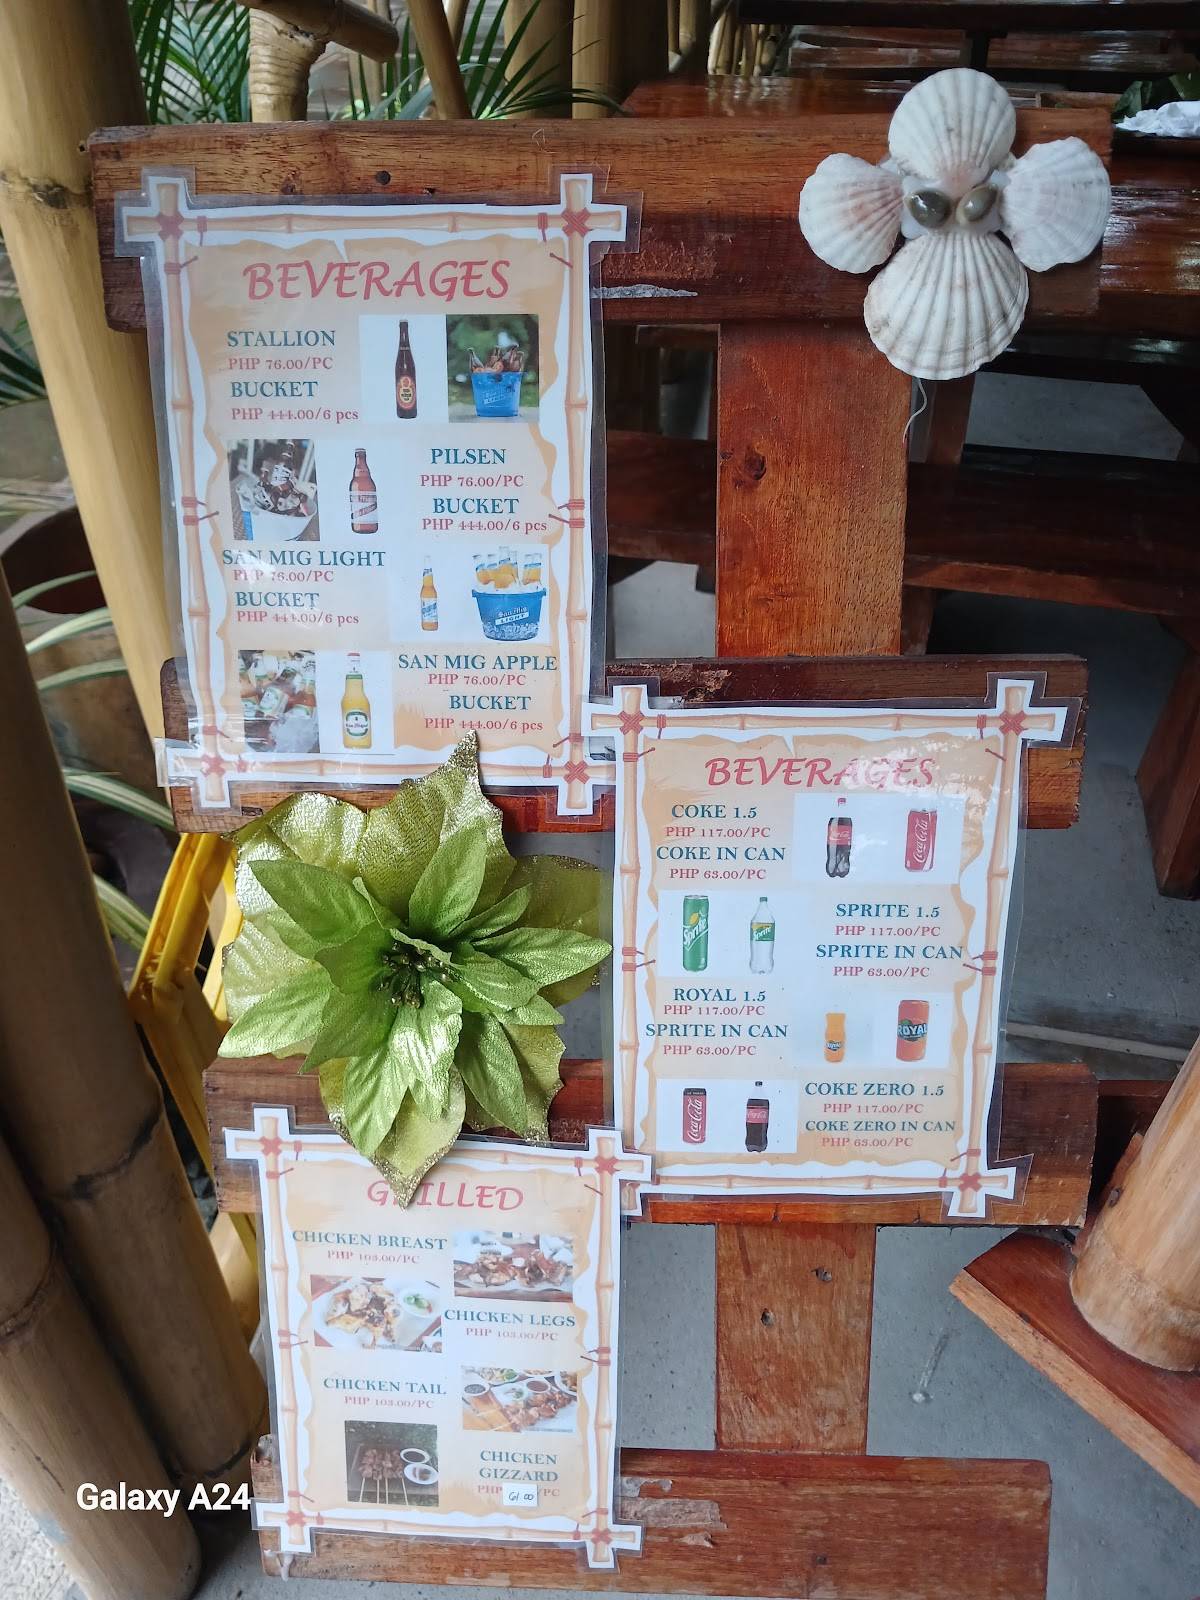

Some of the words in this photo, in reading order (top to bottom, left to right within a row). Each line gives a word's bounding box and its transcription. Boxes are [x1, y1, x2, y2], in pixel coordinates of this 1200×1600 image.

[242, 260, 511, 302] BEVERAGES
[227, 331, 335, 347] STALLION
[228, 358, 260, 370] PHP
[266, 357, 333, 370] 76.00/PC
[232, 382, 318, 397] BUCKET
[232, 408, 262, 420] PHP
[336, 410, 358, 424] pcs
[431, 449, 506, 465] PILSEN
[421, 475, 452, 487] PHP
[457, 475, 524, 487] 76.00/PC
[433, 498, 519, 514] BUCKET
[422, 519, 453, 530] PHP
[459, 519, 520, 531] 444.00/6
[525, 521, 547, 534] pcs
[269, 551, 311, 565] MIG
[320, 551, 386, 566] LIGHT
[235, 592, 319, 607] BUCKET
[237, 611, 267, 622] PHP
[337, 614, 359, 627] pcs
[399, 655, 437, 669] SAN
[445, 655, 486, 669] MIG
[494, 656, 557, 670] APPLE
[428, 674, 458, 684] PHP
[464, 674, 527, 685] 76.00/PC
[450, 696, 531, 710] BUCKET
[425, 718, 454, 729] PHP
[522, 720, 543, 733] pcs
[705, 757, 936, 789] BEVERAGES
[672, 805, 726, 818] COKE
[734, 807, 757, 818] 1.5
[666, 827, 695, 837] PHP
[701, 826, 771, 837] 117.00/PC
[657, 847, 710, 860] COKE
[717, 847, 737, 860] IN
[744, 848, 786, 861] CAN
[670, 869, 699, 879] PHP
[704, 869, 766, 879] 63.00/PC
[836, 904, 909, 917] SPRITE
[917, 907, 940, 917] 1.5
[835, 926, 865, 936] PHP
[871, 926, 941, 936] 117.00/PC
[816, 945, 888, 958] SPRITE
[895, 945, 915, 958] IN
[922, 946, 963, 958] CAN
[834, 967, 863, 976] PHP
[868, 967, 930, 977] 63.00/PC
[674, 989, 736, 1001] ROYAL
[744, 991, 766, 1001] 1.5
[664, 1005, 692, 1015] PHP
[698, 1005, 765, 1015] 117.00/PC
[646, 1024, 715, 1036] SPRITE
[722, 1025, 741, 1037] IN
[748, 1025, 787, 1038] CAN
[664, 1045, 691, 1055] PHP
[697, 1045, 757, 1055] 63.00/PC
[805, 1083, 857, 1095] COKE
[864, 1083, 914, 1096] ZERO
[922, 1085, 944, 1096] 1.5
[823, 1104, 852, 1113] PHP
[857, 1104, 924, 1113] 117.00/PC
[805, 1120, 848, 1131] COKE
[854, 1121, 896, 1131] ZERO
[901, 1121, 918, 1131] IN
[923, 1121, 955, 1131] CAN
[822, 1138, 849, 1146] PHP
[367, 1180, 524, 1210] GILLED
[293, 1230, 371, 1245] CHICKEN
[378, 1237, 447, 1250] BREAST
[328, 1250, 353, 1260] PHP
[445, 1310, 523, 1323] CHICKEN
[530, 1315, 576, 1326] LEGS
[466, 1328, 492, 1336] PHP
[323, 1376, 401, 1392] CHICKEN
[405, 1382, 447, 1395] TAIL
[345, 1396, 370, 1405] PHP
[480, 1450, 557, 1464] CHICKEN
[479, 1467, 558, 1481] GIZZARD
[478, 1485, 502, 1493] PHP
